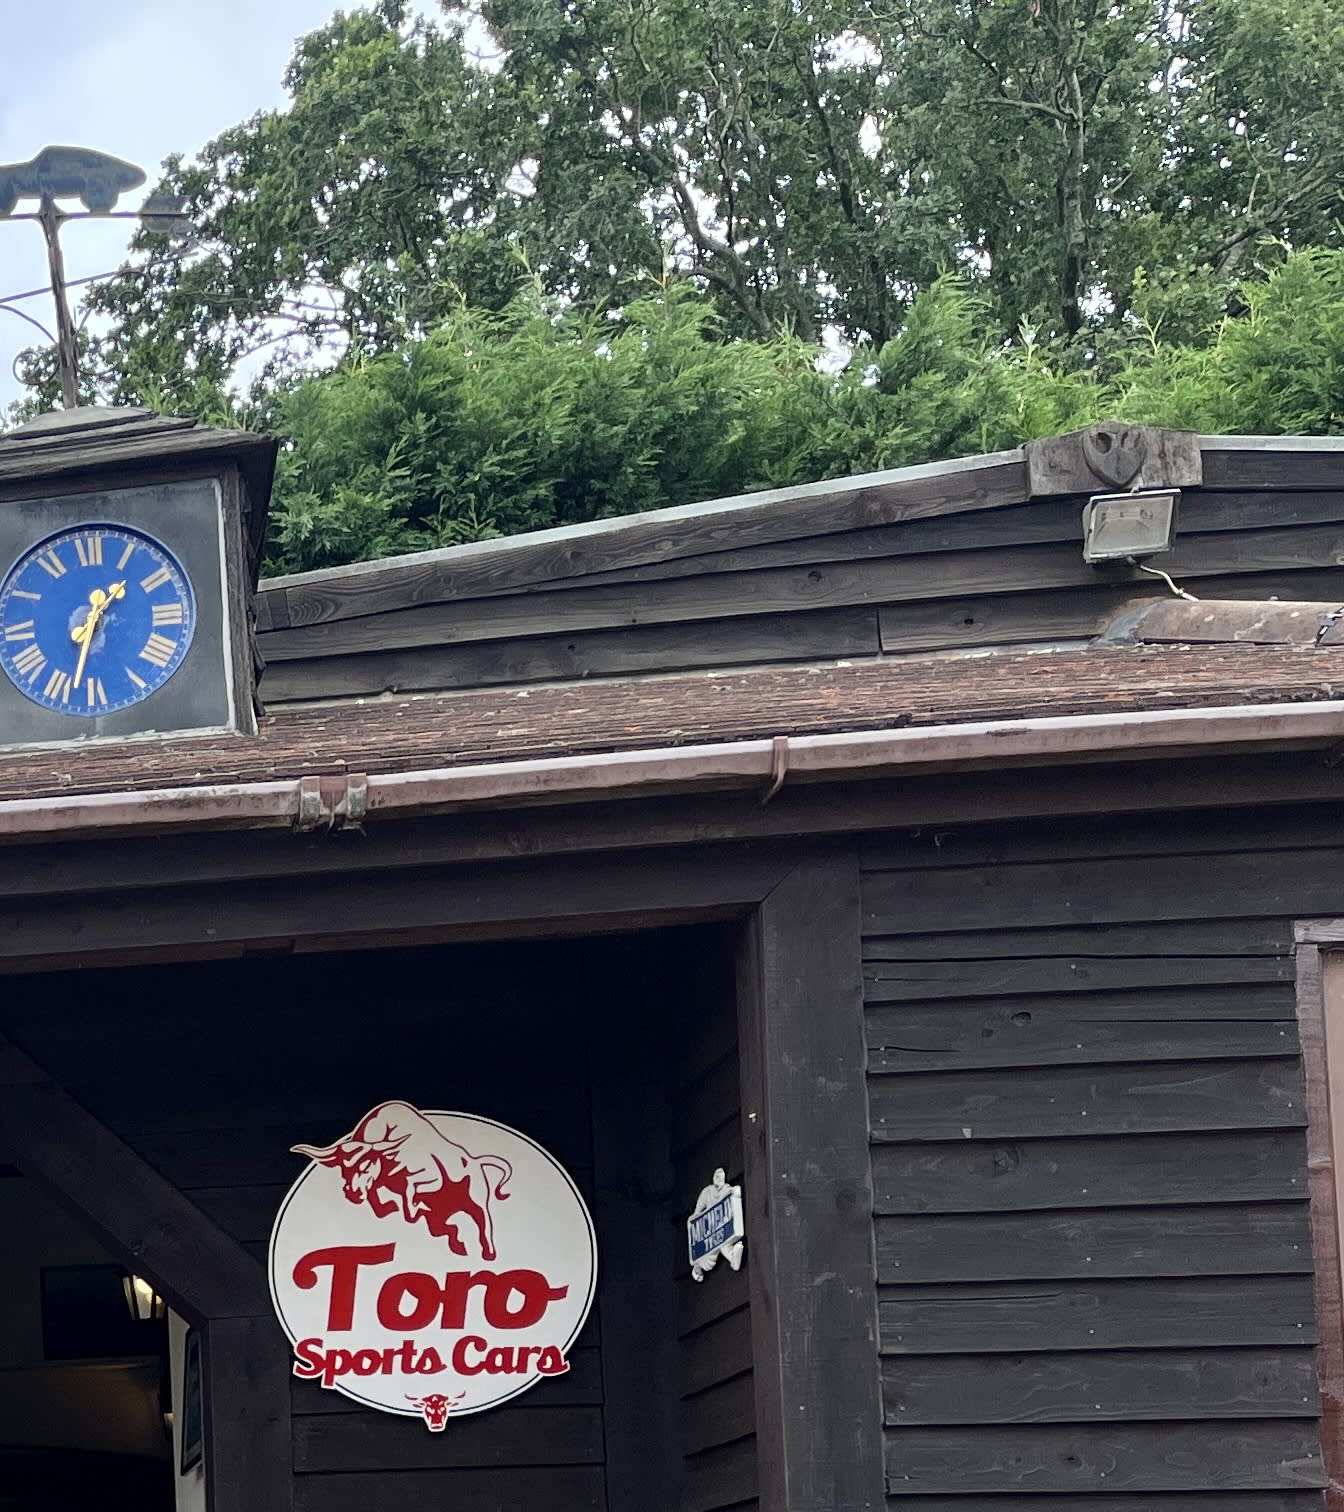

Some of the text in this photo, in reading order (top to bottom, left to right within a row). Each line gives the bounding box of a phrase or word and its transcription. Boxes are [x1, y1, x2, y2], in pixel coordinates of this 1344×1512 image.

[292, 1242, 569, 1332] Toro
[295, 1335, 570, 1387] Sports Cars
